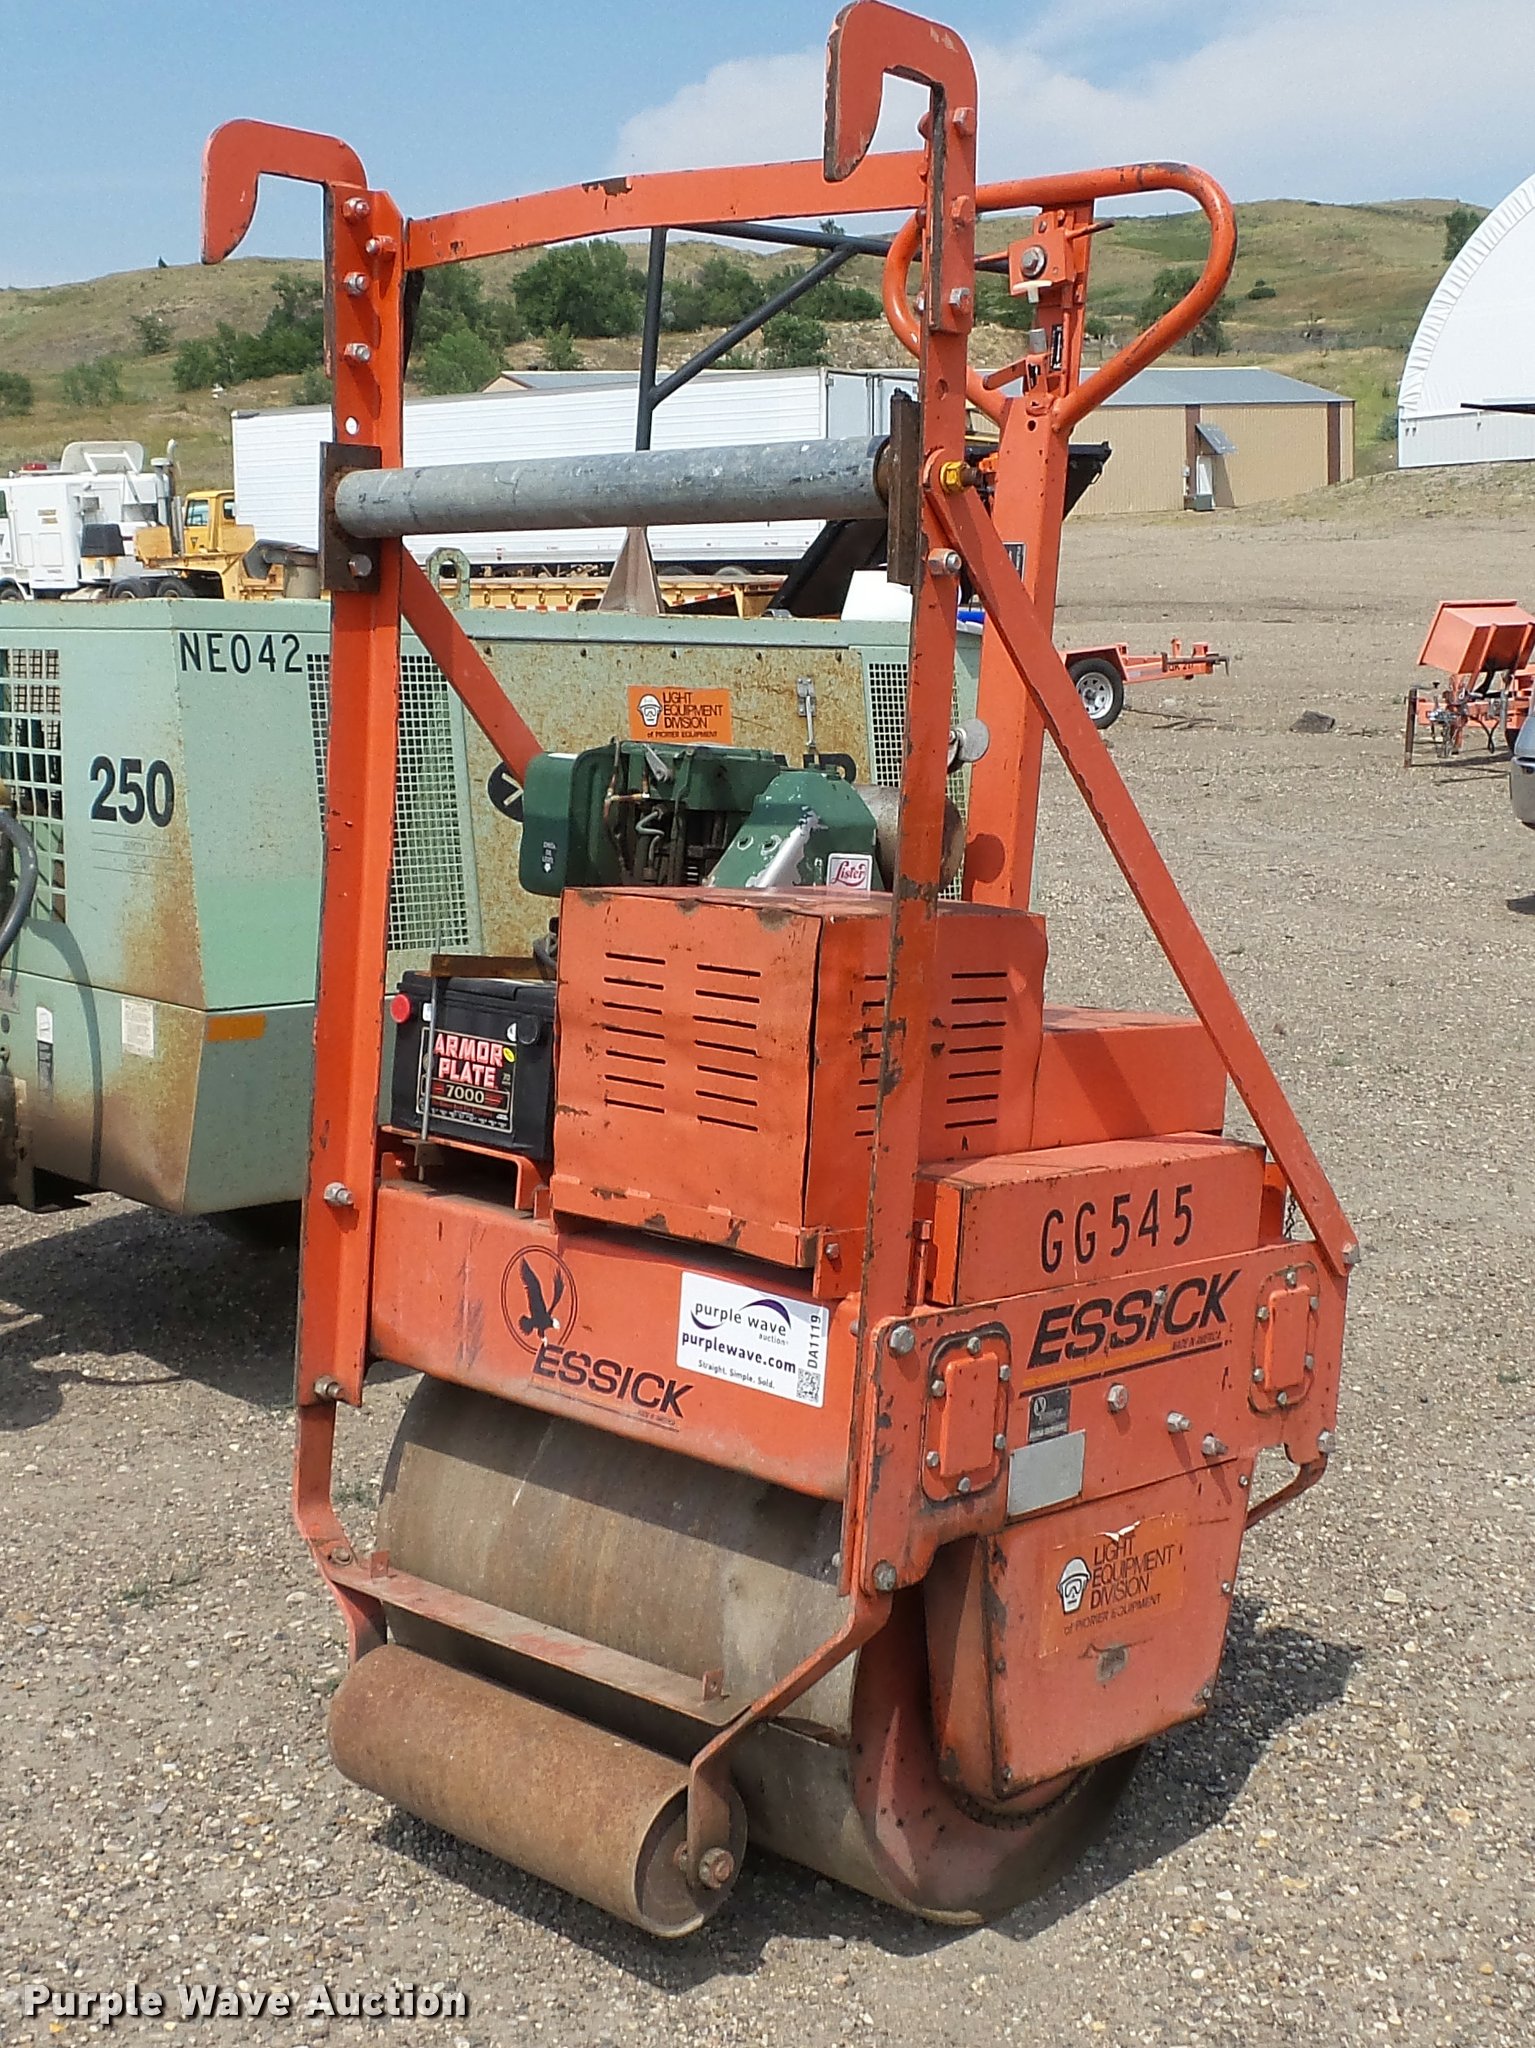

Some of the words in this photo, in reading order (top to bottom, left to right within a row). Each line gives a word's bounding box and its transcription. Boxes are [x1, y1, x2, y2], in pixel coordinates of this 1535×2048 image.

[662, 692, 693, 704] LIGHT
[663, 705, 723, 716] EQUIPMENT
[664, 717, 708, 729] DIVISION
[90, 755, 175, 828] 250
[830, 860, 867, 886] Lister
[434, 1033, 504, 1068] ARMOR
[438, 1057, 497, 1088] PLATE
[446, 1084, 485, 1103] 7000
[1041, 1184, 1193, 1273] GG545
[695, 1303, 742, 1324] purple
[748, 1316, 786, 1336] wave
[1027, 1269, 1241, 1369] ESSICK
[682, 1332, 796, 1374] purplewave.com
[758, 1333, 786, 1346] auction
[807, 1314, 821, 1369] DA1119
[532, 1343, 693, 1418] ESSICK
[758, 1377, 775, 1389] Sold.
[1092, 1544, 1174, 1588] EQUIPMENT
[1094, 1535, 1135, 1566] LIGHT
[1091, 1572, 1149, 1609] DIVISION
